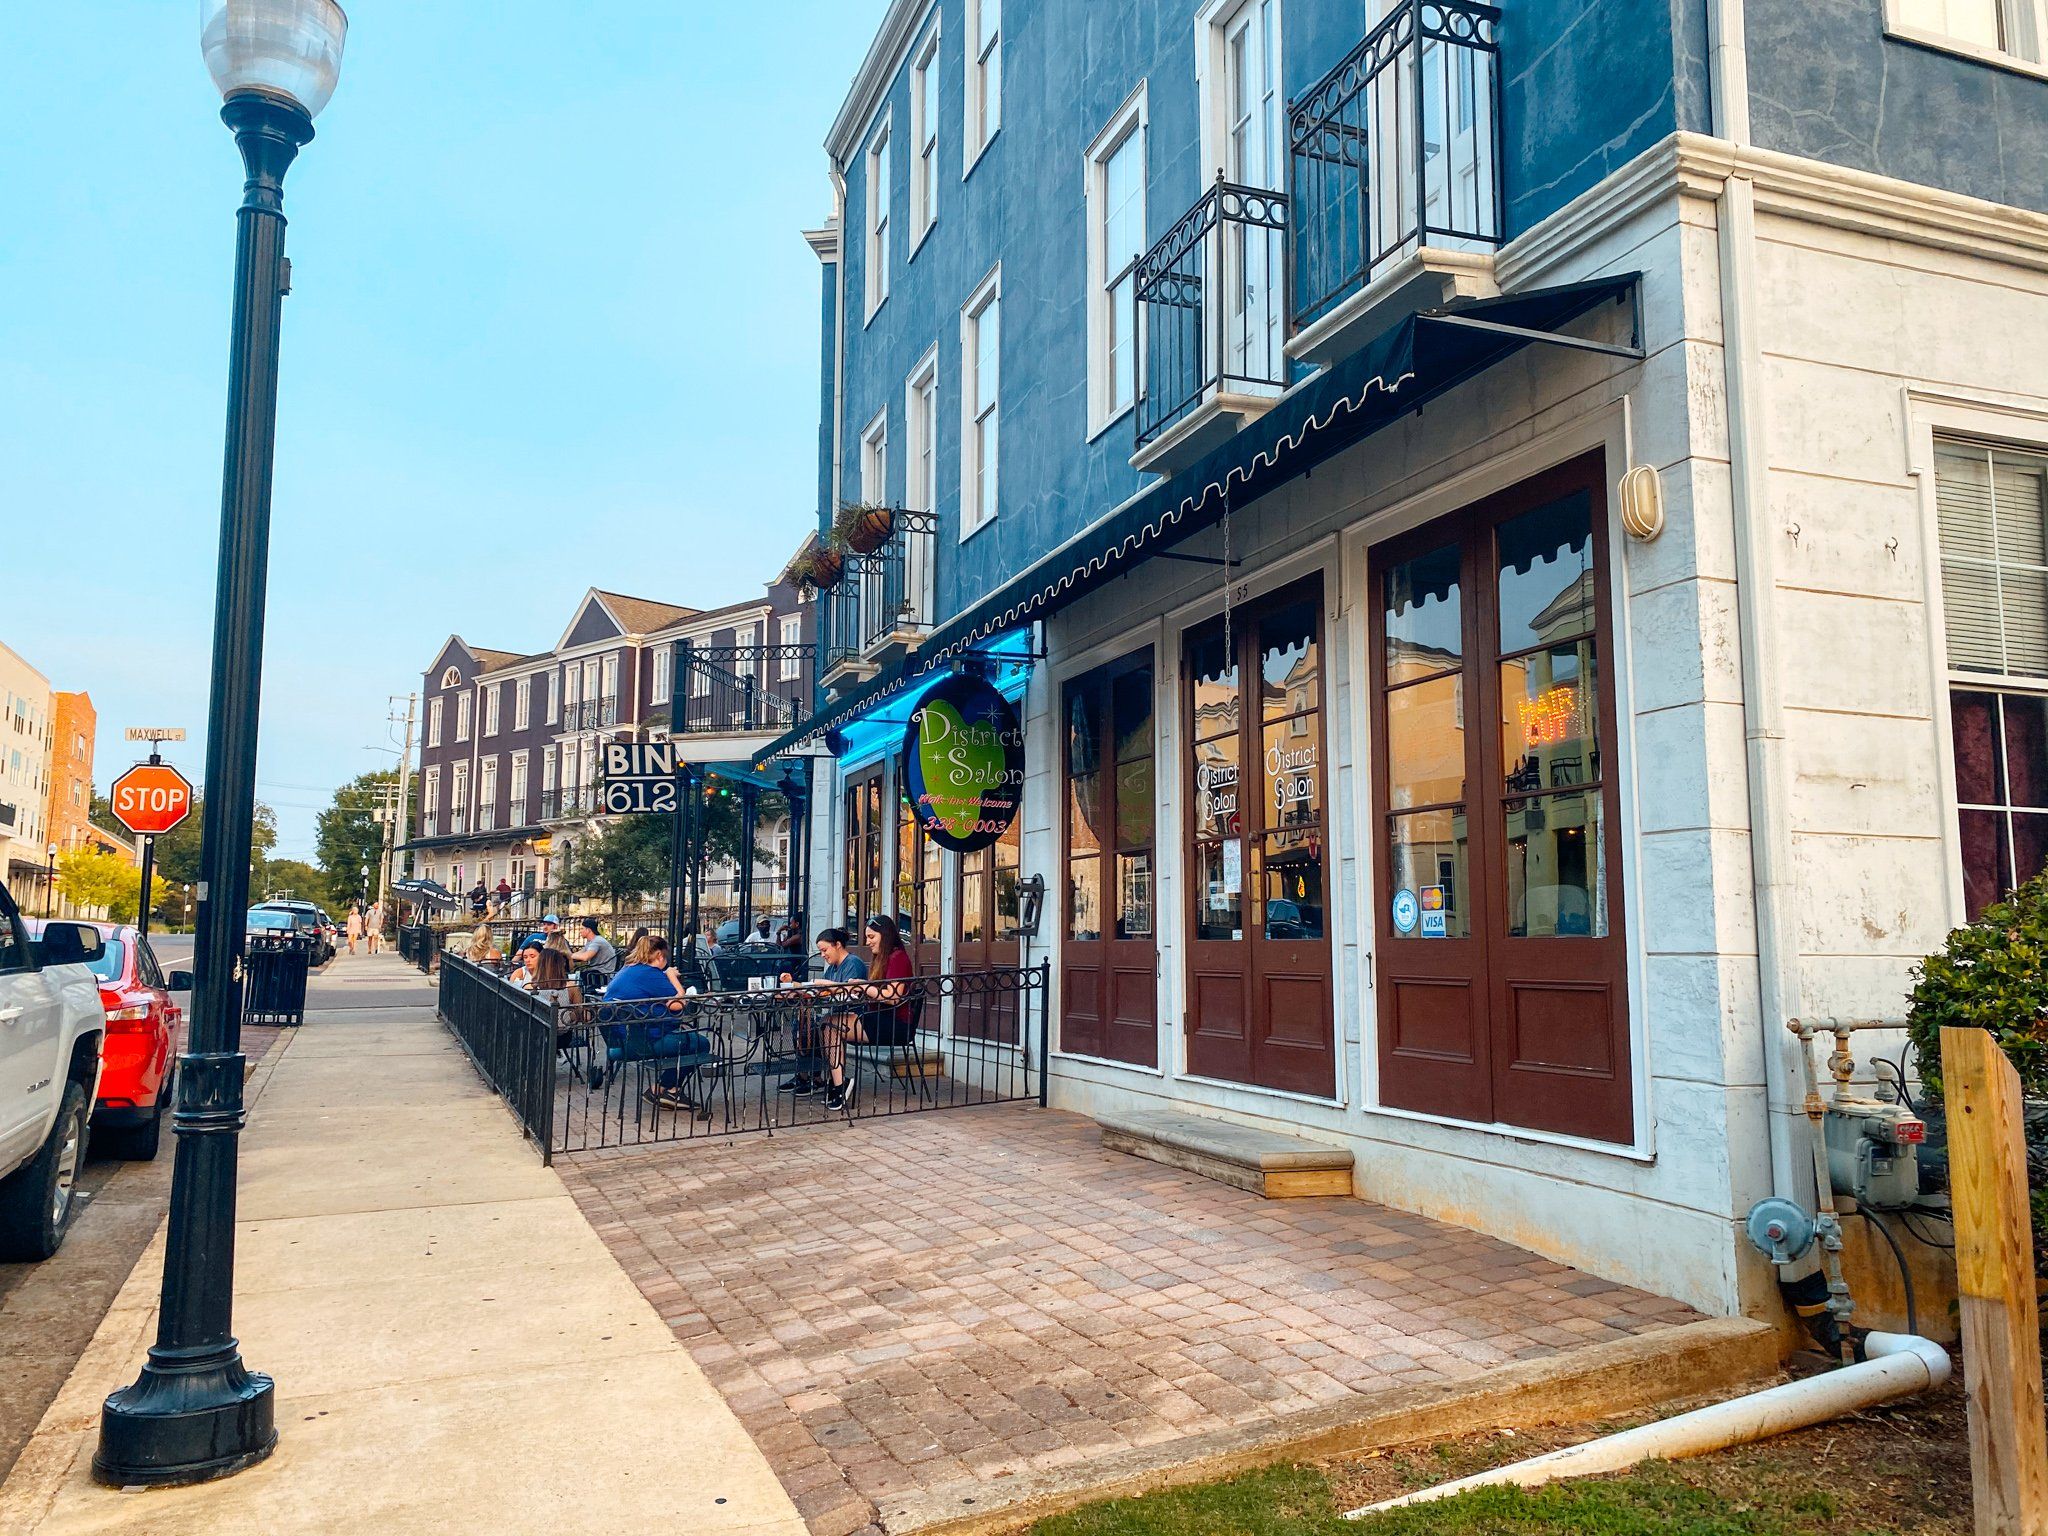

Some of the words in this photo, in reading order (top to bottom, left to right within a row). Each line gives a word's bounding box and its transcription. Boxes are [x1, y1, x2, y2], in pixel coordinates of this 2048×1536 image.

[1518, 687, 1576, 726] HAIR
[129, 729, 172, 740] MAXWELL
[911, 707, 1023, 747] District
[1525, 713, 1569, 746] CUT
[607, 744, 672, 775] BIN
[947, 747, 1024, 786] Salon
[118, 786, 185, 812] STOP
[606, 781, 677, 813] 612
[967, 796, 1013, 809] Welcome
[1424, 916, 1444, 928] VISA
